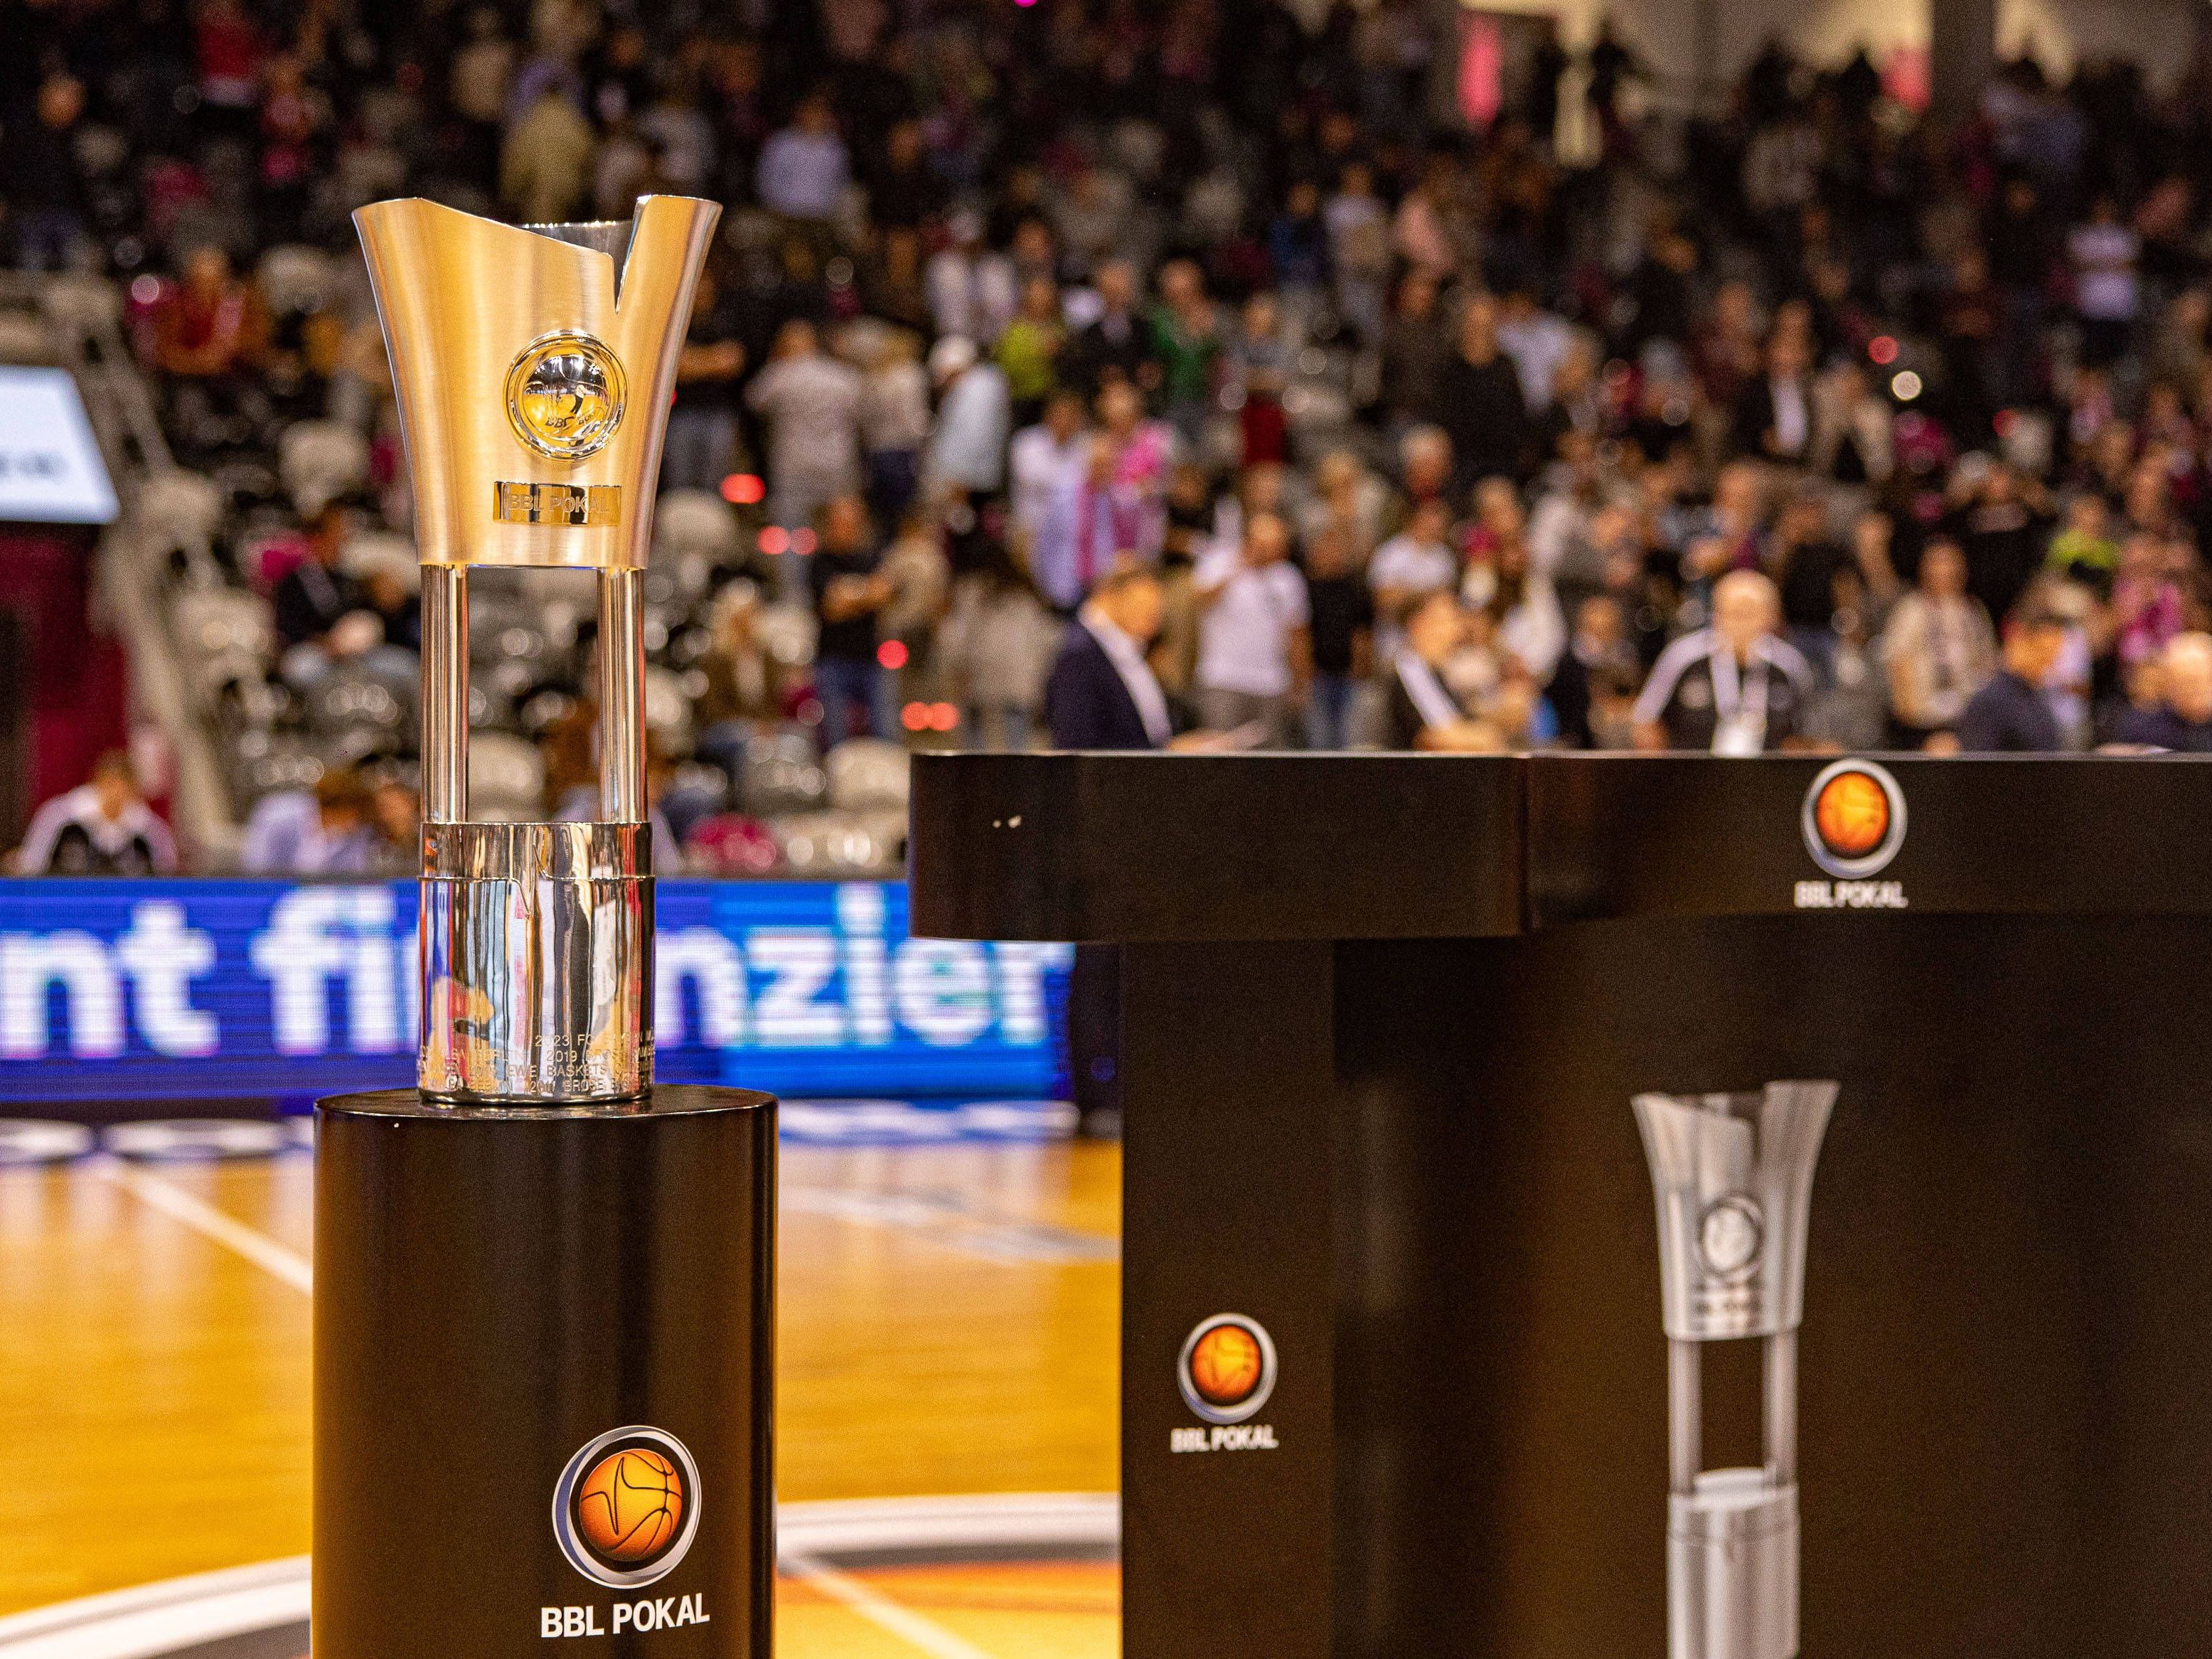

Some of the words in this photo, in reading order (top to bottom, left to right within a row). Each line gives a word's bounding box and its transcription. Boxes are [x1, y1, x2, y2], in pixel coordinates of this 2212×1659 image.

[508, 494, 542, 511] BBL
[549, 496, 610, 513] POKAL
[1835, 880, 1909, 908] POKAL
[249, 882, 1075, 1055] finzier
[547, 1050, 578, 1062] 2019
[507, 1065, 538, 1078] EWE
[547, 1063, 608, 1077] BASKETS
[1211, 1424, 1280, 1451] POKAL
[541, 1605, 604, 1638] BBL
[613, 1593, 710, 1634] POKAL
